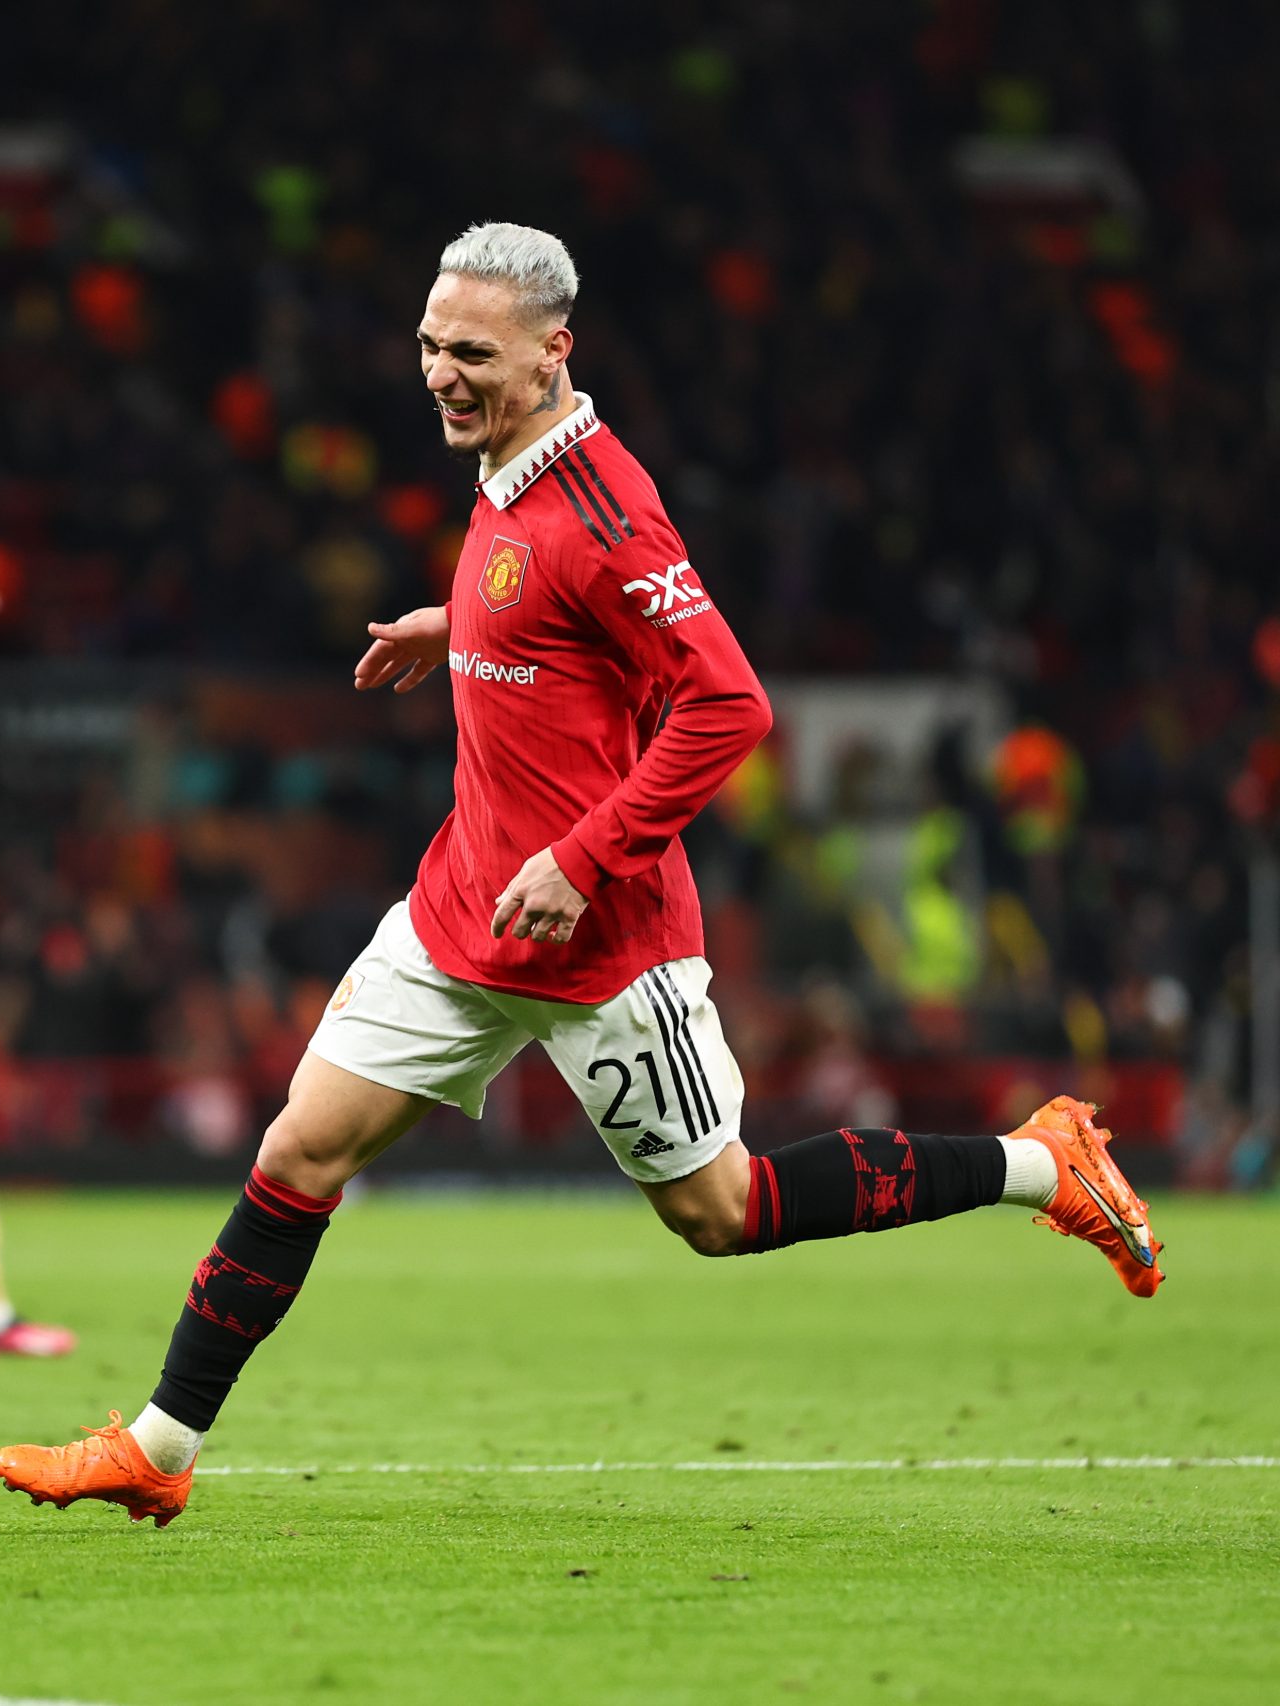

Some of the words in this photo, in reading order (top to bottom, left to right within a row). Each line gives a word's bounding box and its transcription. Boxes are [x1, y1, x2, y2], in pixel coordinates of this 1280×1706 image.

[622, 560, 704, 617] DXC
[587, 1050, 667, 1130] 21
[631, 1142, 675, 1158] adidas
